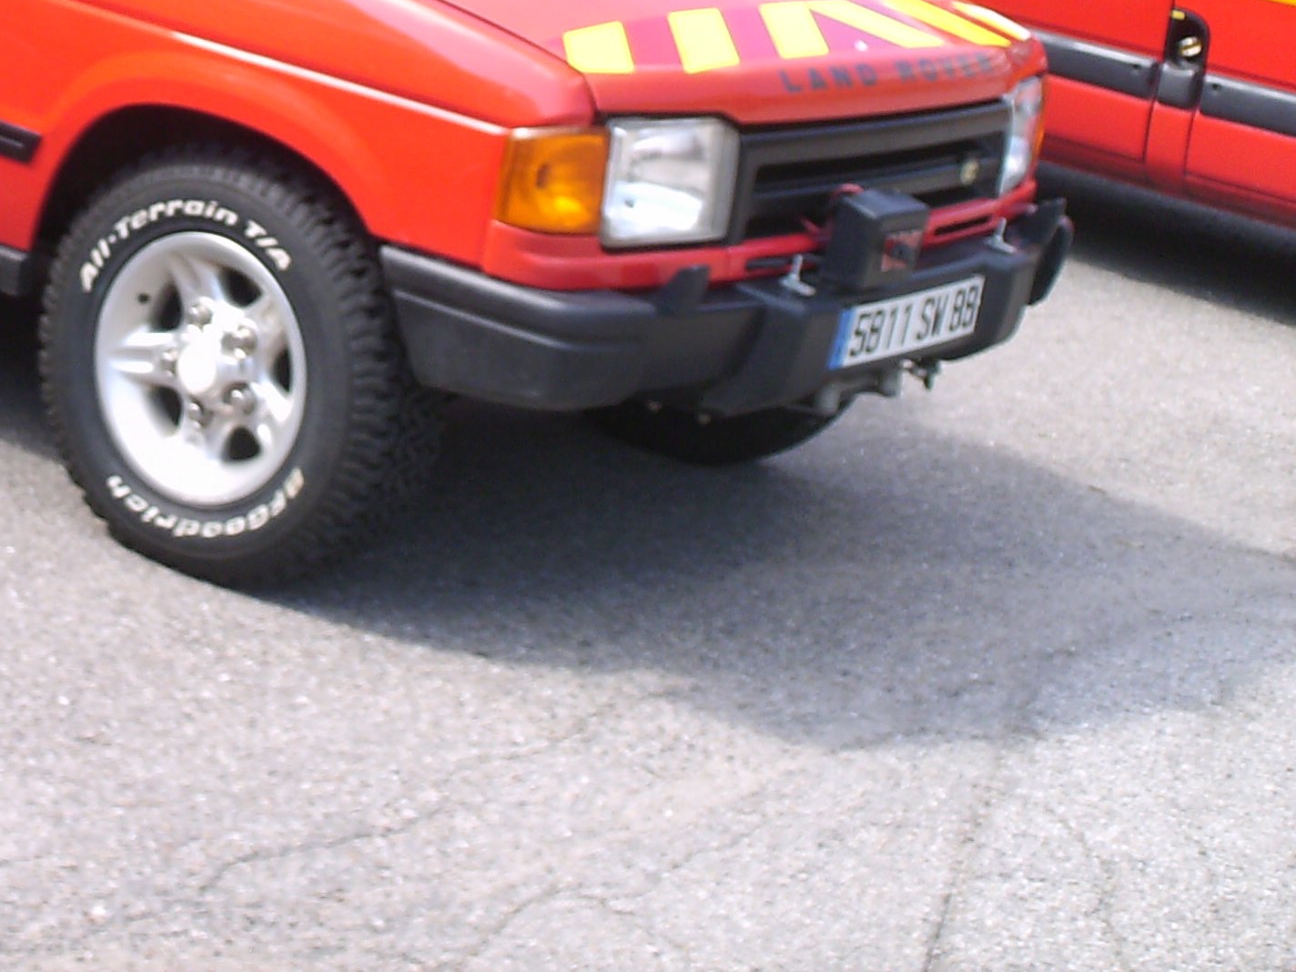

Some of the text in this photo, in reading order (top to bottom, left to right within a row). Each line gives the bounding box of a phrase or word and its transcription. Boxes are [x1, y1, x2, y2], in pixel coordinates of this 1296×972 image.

[777, 50, 995, 94] LAND ROVER
[245, 218, 293, 272] T/A
[916, 292, 950, 341] SW
